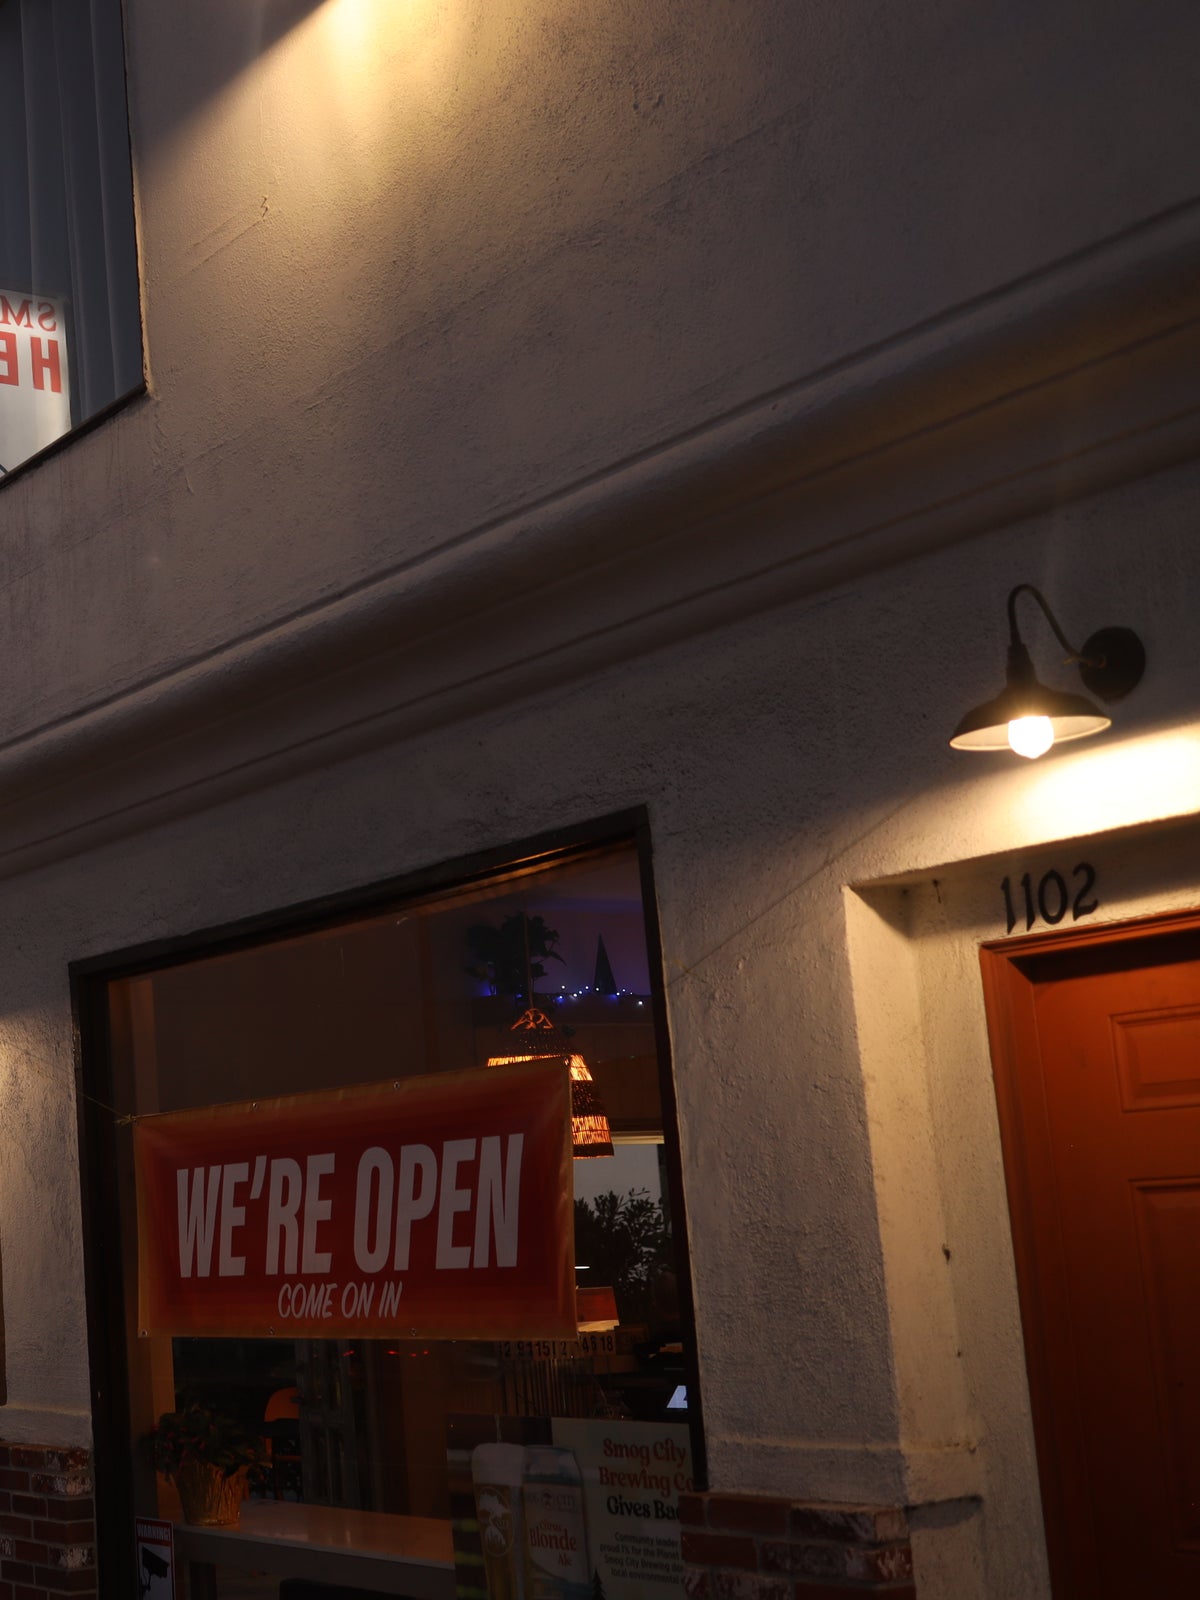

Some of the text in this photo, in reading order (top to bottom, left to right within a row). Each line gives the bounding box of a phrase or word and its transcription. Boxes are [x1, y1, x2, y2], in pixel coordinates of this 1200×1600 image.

[1001, 862, 1099, 935] 1102
[176, 1132, 525, 1279] WE'RE OPEN
[277, 1280, 403, 1320] COME ON IN
[603, 1438, 686, 1468] Smog City
[598, 1466, 671, 1498] Brewing
[606, 1495, 650, 1518] Gives
[529, 1526, 577, 1552] Blonde
